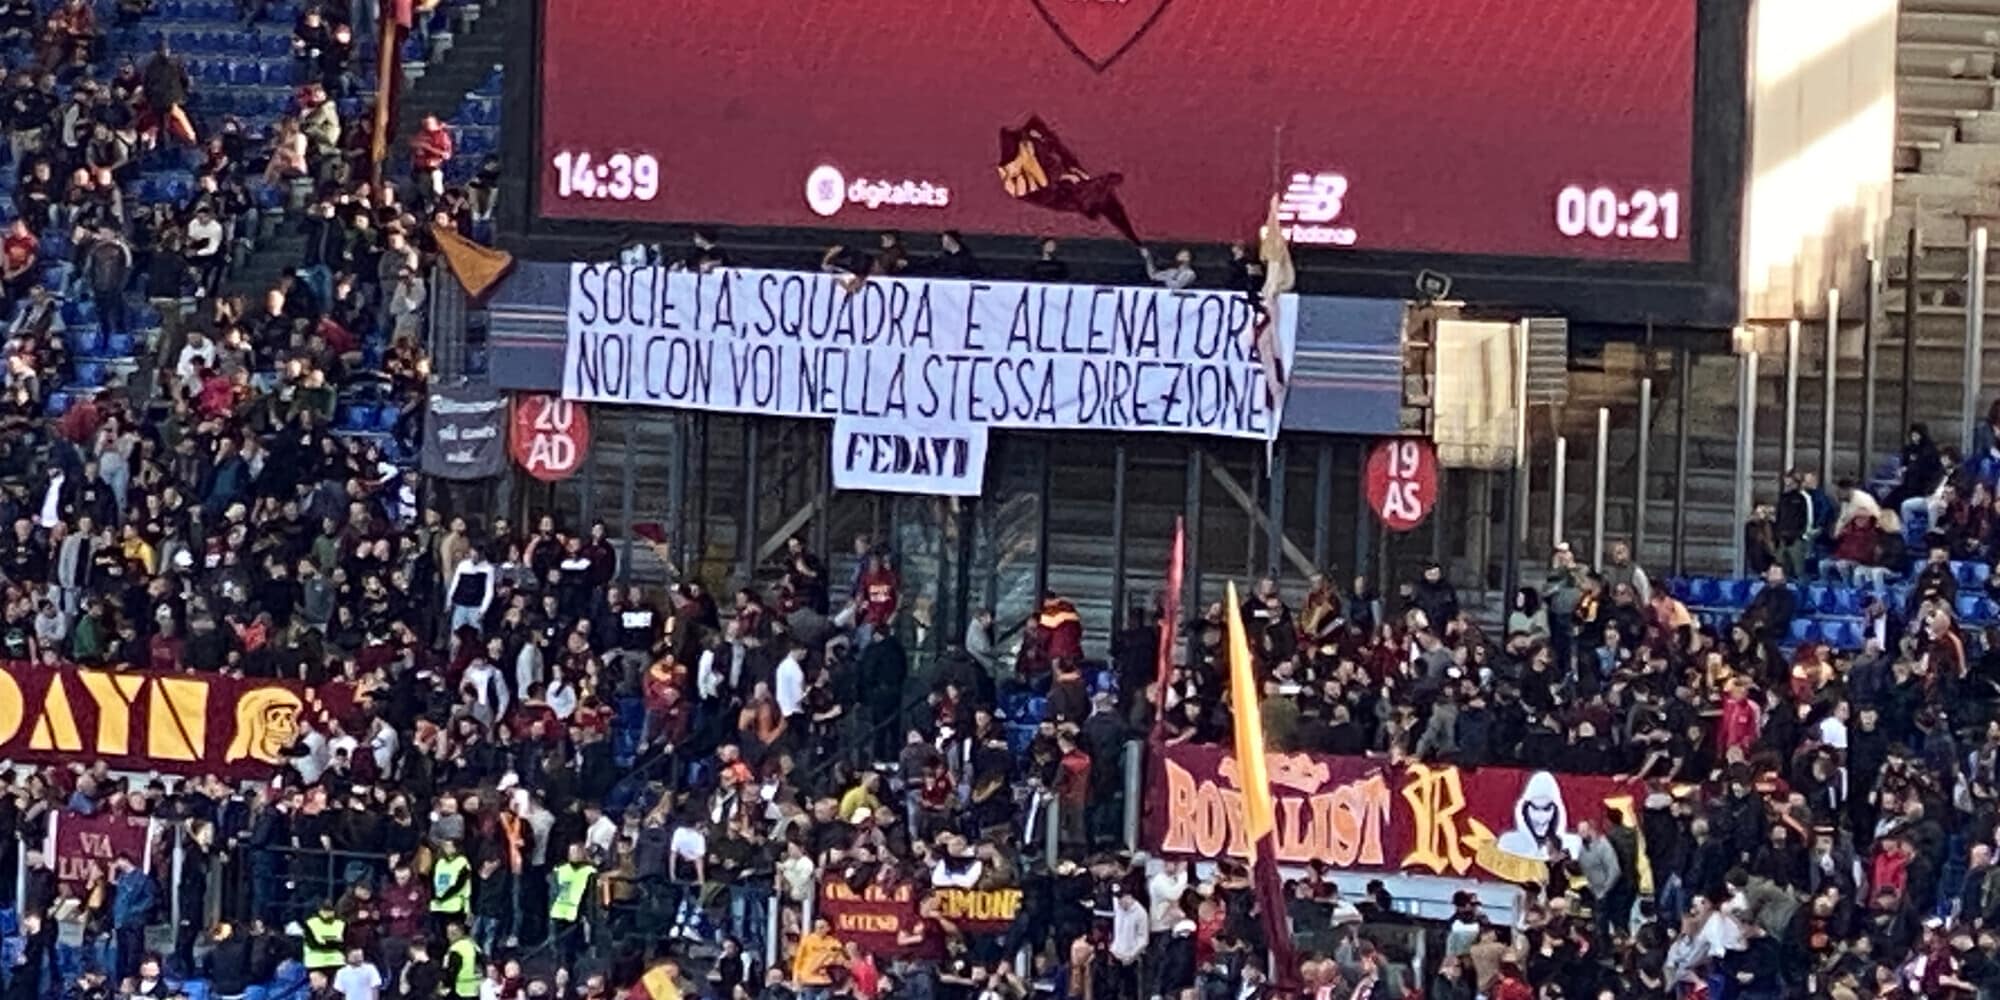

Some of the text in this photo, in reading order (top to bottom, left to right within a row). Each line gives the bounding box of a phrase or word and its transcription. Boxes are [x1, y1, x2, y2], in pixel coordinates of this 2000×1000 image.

[553, 151, 660, 201] 14:39
[1556, 185, 1680, 240] 00:21
[754, 272, 933, 348] SQUADRA
[964, 282, 992, 352] E
[576, 331, 1267, 433] NOI CON VOI NELLA STESSA DIREZIONE
[534, 396, 574, 432] 20
[526, 432, 576, 471] AD
[1387, 441, 1420, 478] 19
[1382, 480, 1423, 520] AS
[80, 831, 114, 859] VIA
